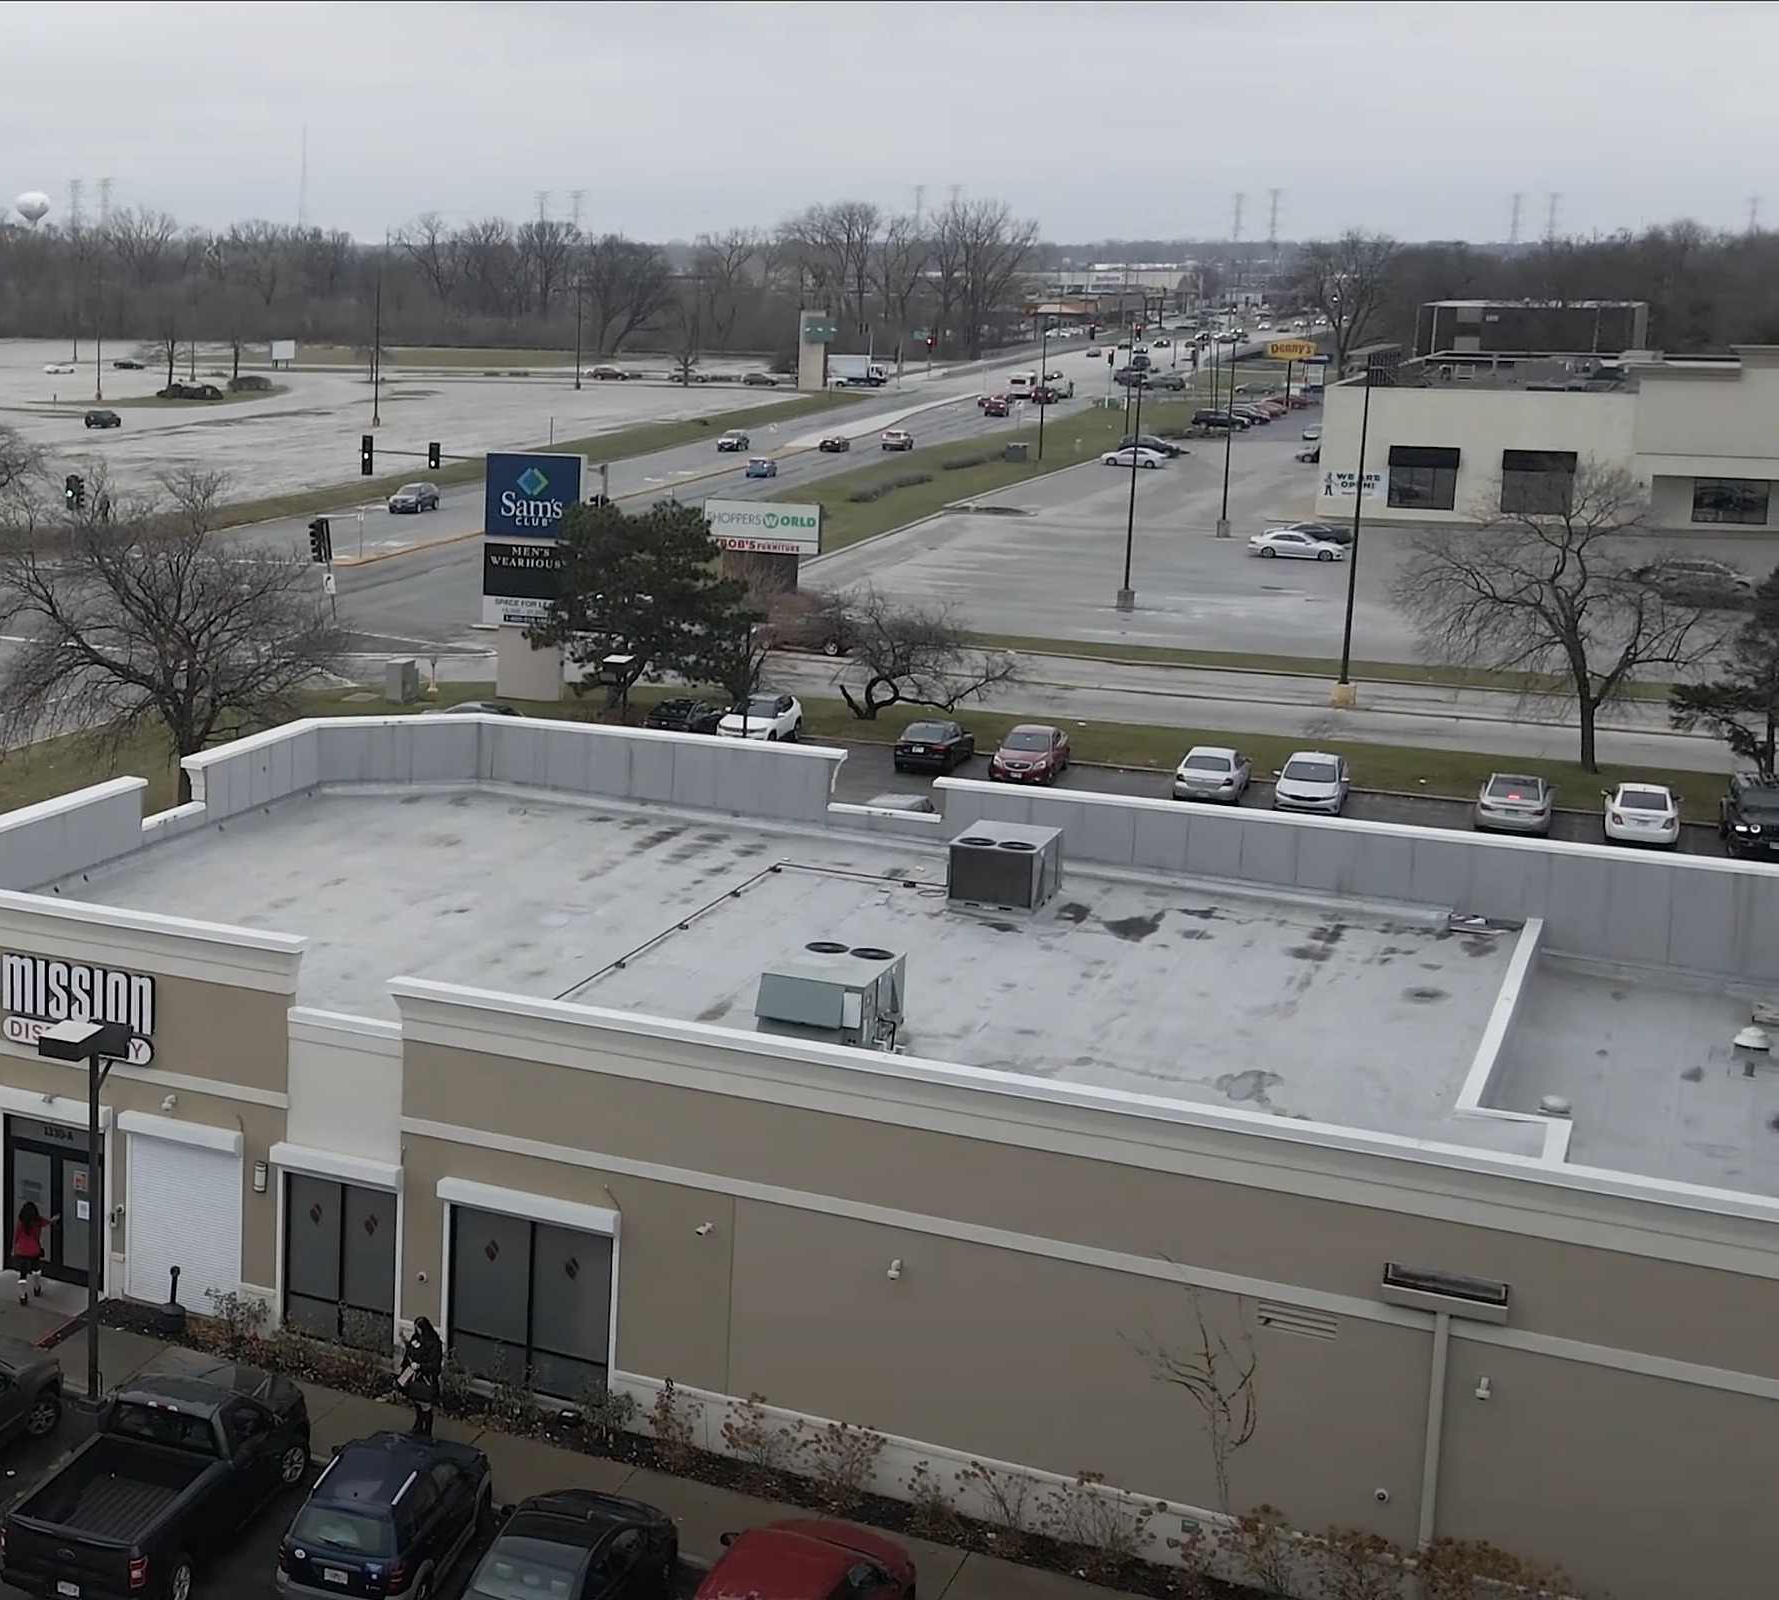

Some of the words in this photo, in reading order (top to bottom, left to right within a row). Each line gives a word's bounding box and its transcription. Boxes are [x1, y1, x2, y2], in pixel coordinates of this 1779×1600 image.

[1271, 343, 1312, 355] Denny's
[1336, 472, 1354, 480] WE
[1341, 481, 1375, 490] OPN!
[500, 491, 563, 520] Sam's
[515, 516, 548, 527] CLUB
[707, 511, 762, 526] SHOPPERS
[763, 512, 816, 529] WORLD
[511, 546, 550, 558] MEN'S
[490, 556, 567, 570] WEARHOUS
